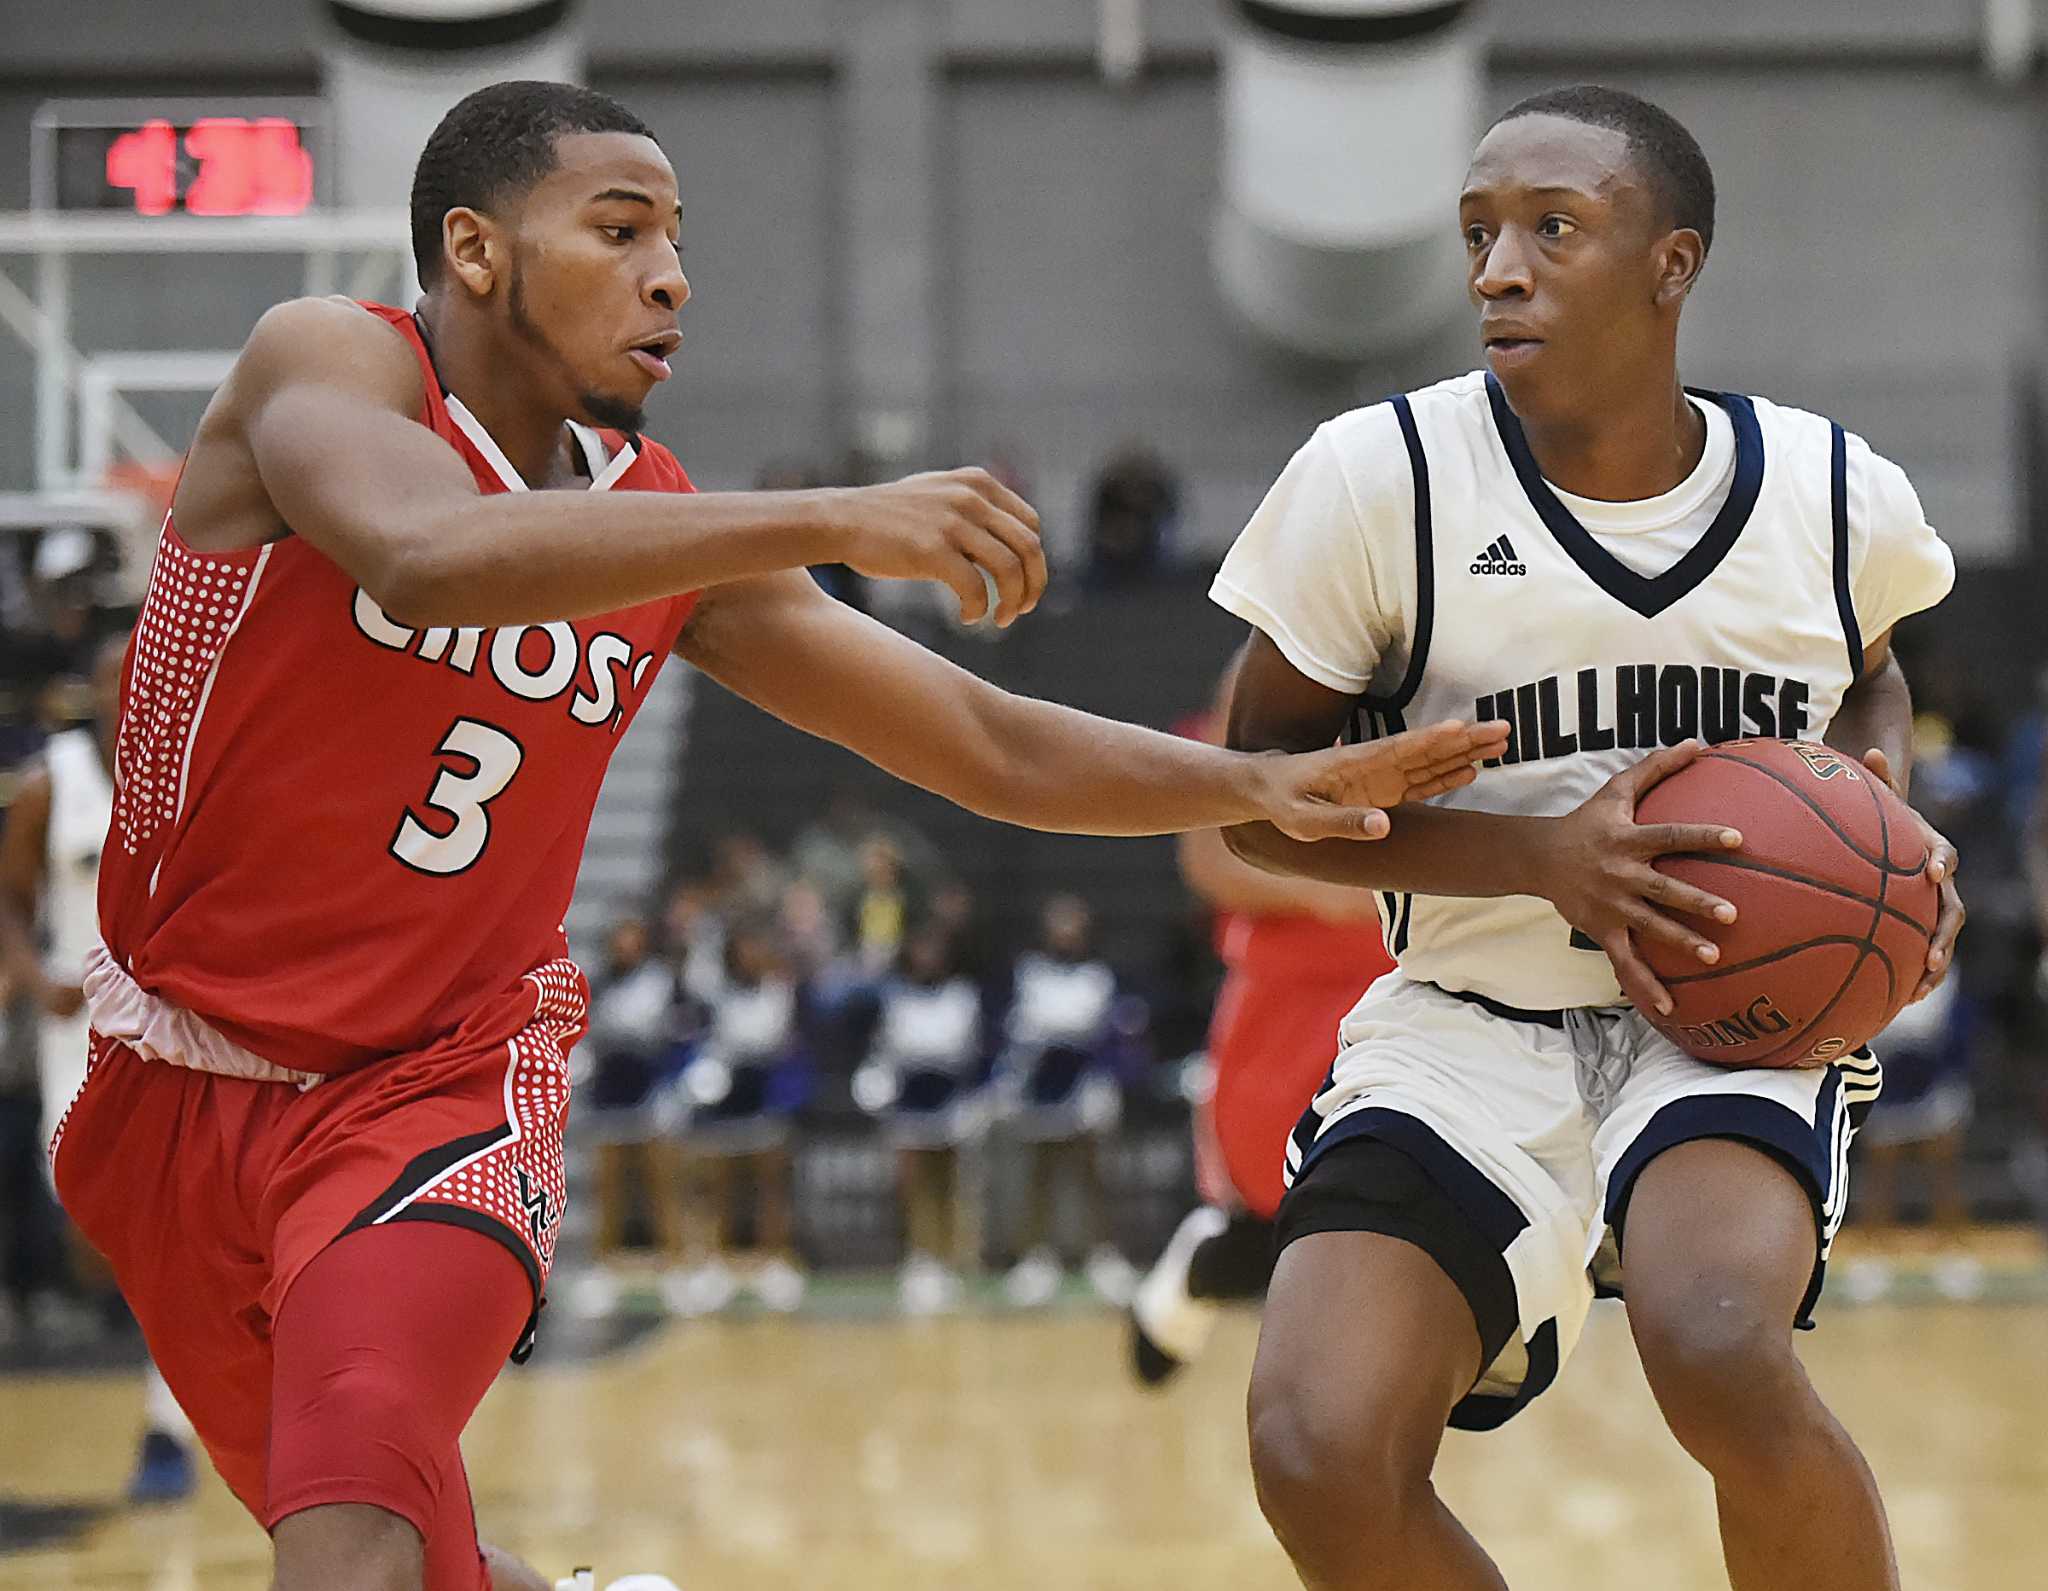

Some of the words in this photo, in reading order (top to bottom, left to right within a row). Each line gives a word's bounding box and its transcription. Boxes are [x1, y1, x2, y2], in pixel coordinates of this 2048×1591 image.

[1469, 559, 1527, 576] adidas
[352, 586, 656, 736] COS
[1475, 663, 1809, 769] HILLHOUSE
[387, 714, 525, 878] 3
[1662, 993, 1792, 1048] DING
